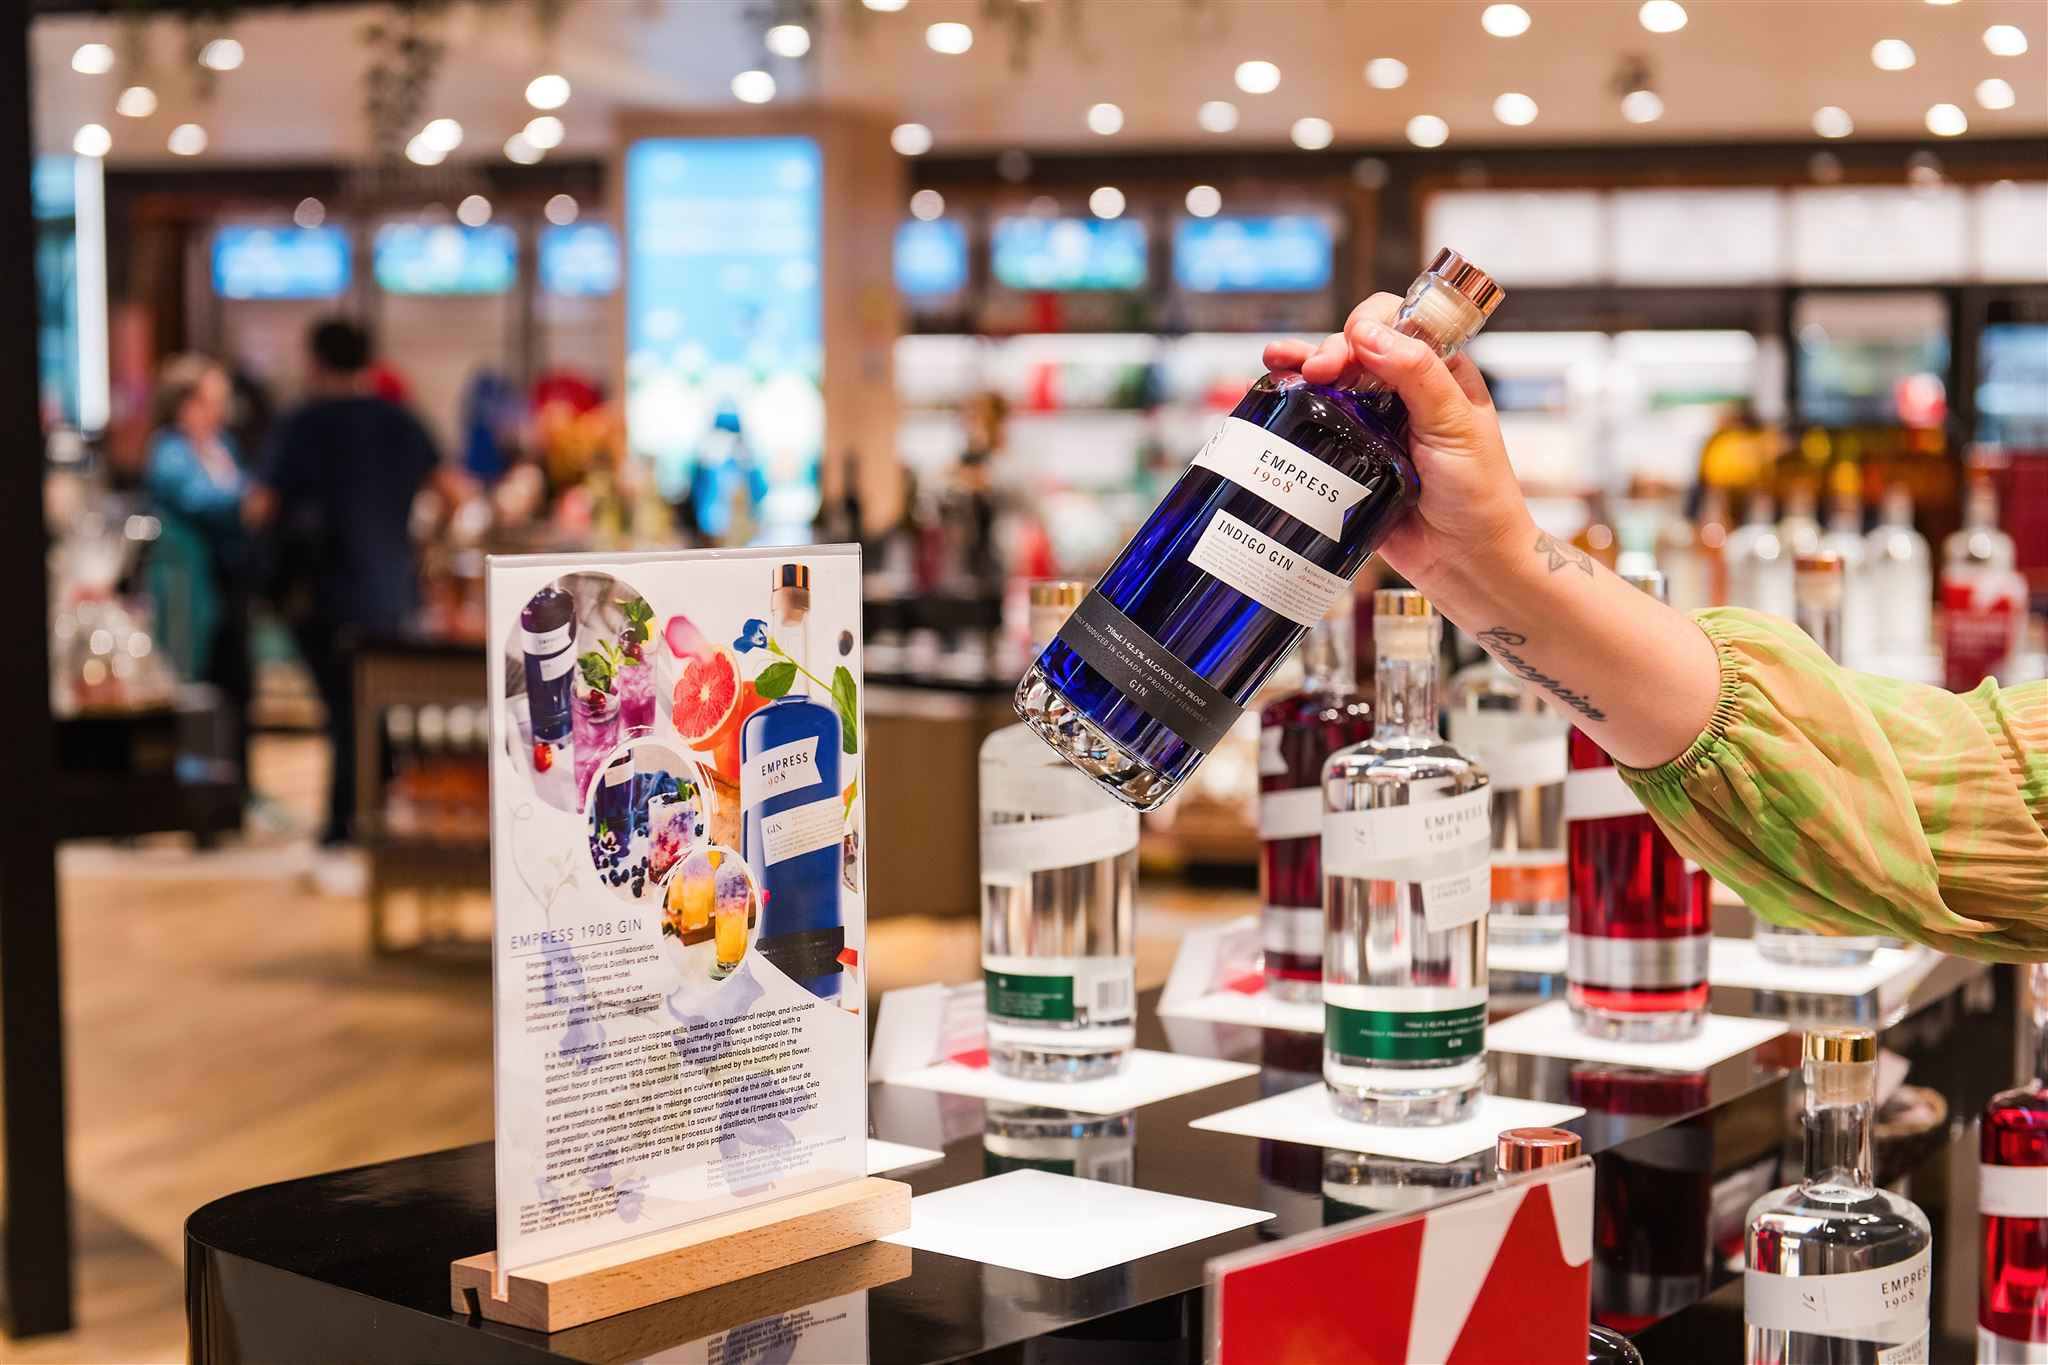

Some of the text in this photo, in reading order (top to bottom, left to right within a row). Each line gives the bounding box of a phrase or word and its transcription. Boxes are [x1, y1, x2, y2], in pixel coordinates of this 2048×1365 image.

[1253, 466, 1294, 494] 1908
[1259, 449, 1340, 503] EMPRESS
[1217, 520, 1294, 571] INDIGO GIN
[1084, 622, 1109, 646] PRODUCED
[1108, 644, 1117, 653] IN
[1116, 651, 1142, 675] CANADA
[1146, 676, 1176, 700] PRODUIT
[1105, 624, 1207, 707] 750mL 42.5% ALC/VOL 85 PROOF
[1129, 680, 1148, 698] GIN
[761, 752, 809, 777] EMPRESS
[766, 822, 783, 836] GIN
[510, 918, 642, 950] EMPRESS 1908 GIN
[545, 1062, 555, 1071] the
[557, 1058, 579, 1069] hotel's
[581, 1053, 612, 1065] signature
[614, 1047, 632, 1058] blend
[634, 1045, 641, 1054] of
[642, 1041, 660, 1052] black
[661, 1041, 672, 1049] tea
[674, 1036, 686, 1046] and
[687, 1031, 713, 1044] butterfly
[714, 1030, 726, 1040] pea
[726, 1027, 747, 1036] flower,
[752, 1017, 782, 1031] botanical
[782, 1015, 796, 1025] with
[608, 1036, 626, 1047] small
[628, 1032, 646, 1044] batch
[648, 1030, 671, 1040] copper
[690, 1020, 709, 1032] based
[724, 1011, 756, 1025] traditional
[756, 1009, 777, 1019] recipe,
[778, 1005, 791, 1015] and
[791, 1001, 815, 1012] includes
[546, 1025, 803, 1083] distinct floral and warm earthy flavor. This gives the gin its unique indigo color. The
[546, 1083, 569, 1096] special
[571, 1081, 590, 1090] flavor
[591, 1077, 598, 1086] of
[599, 1073, 627, 1084] Empress
[629, 1068, 644, 1078] 1908
[645, 1065, 667, 1075] comes
[667, 1062, 681, 1070] from
[682, 1058, 694, 1067] the
[694, 1052, 718, 1065] natural
[718, 1046, 751, 1060] botanicals
[752, 1040, 779, 1053] balanced
[786, 1037, 797, 1046] the
[546, 1094, 581, 1107] distillation
[582, 1089, 609, 1101] process,
[611, 1083, 628, 1093] while
[630, 1080, 641, 1090] the
[642, 1078, 656, 1087] blue
[657, 1074, 673, 1084] color
[680, 1066, 709, 1079] naturally
[710, 1061, 732, 1073] infused
[733, 1059, 742, 1069] by
[742, 1057, 753, 1066] the
[754, 1052, 778, 1064] butterfly
[779, 1051, 791, 1060] pea
[791, 1046, 812, 1056] flower.
[546, 1115, 550, 1123] Il
[590, 1105, 595, 1114] à
[597, 1104, 603, 1112] la
[605, 1100, 622, 1110] main
[623, 1098, 640, 1106] dans
[641, 1094, 652, 1103] des
[654, 1088, 683, 1100] alambics
[693, 1082, 714, 1092] cuivre
[722, 1075, 744, 1087] petites
[745, 1068, 775, 1082] quantités,
[776, 1064, 791, 1074] selon
[606, 1122, 628, 1135] plante
[629, 1116, 661, 1128] botanique
[662, 1112, 678, 1121] avec
[692, 1104, 714, 1114] saveur
[715, 1098, 734, 1109] florale
[735, 1096, 742, 1105] et
[743, 1092, 768, 1103] terreuse
[768, 1084, 805, 1097] chaleureuse.
[806, 1079, 820, 1089] Cela
[618, 1110, 625, 1119] et
[626, 1106, 655, 1118] renferme
[655, 1103, 662, 1111] le
[663, 1098, 692, 1109] mélange
[693, 1087, 740, 1103] caractéristique
[740, 1084, 749, 1093] de
[749, 1081, 760, 1091] thé
[760, 1079, 774, 1088] noir
[773, 1077, 780, 1085] et
[780, 1075, 788, 1084] de
[788, 1073, 802, 1082] fleur
[803, 1070, 811, 1079] de
[1884, 1288, 1915, 1310] 1908
